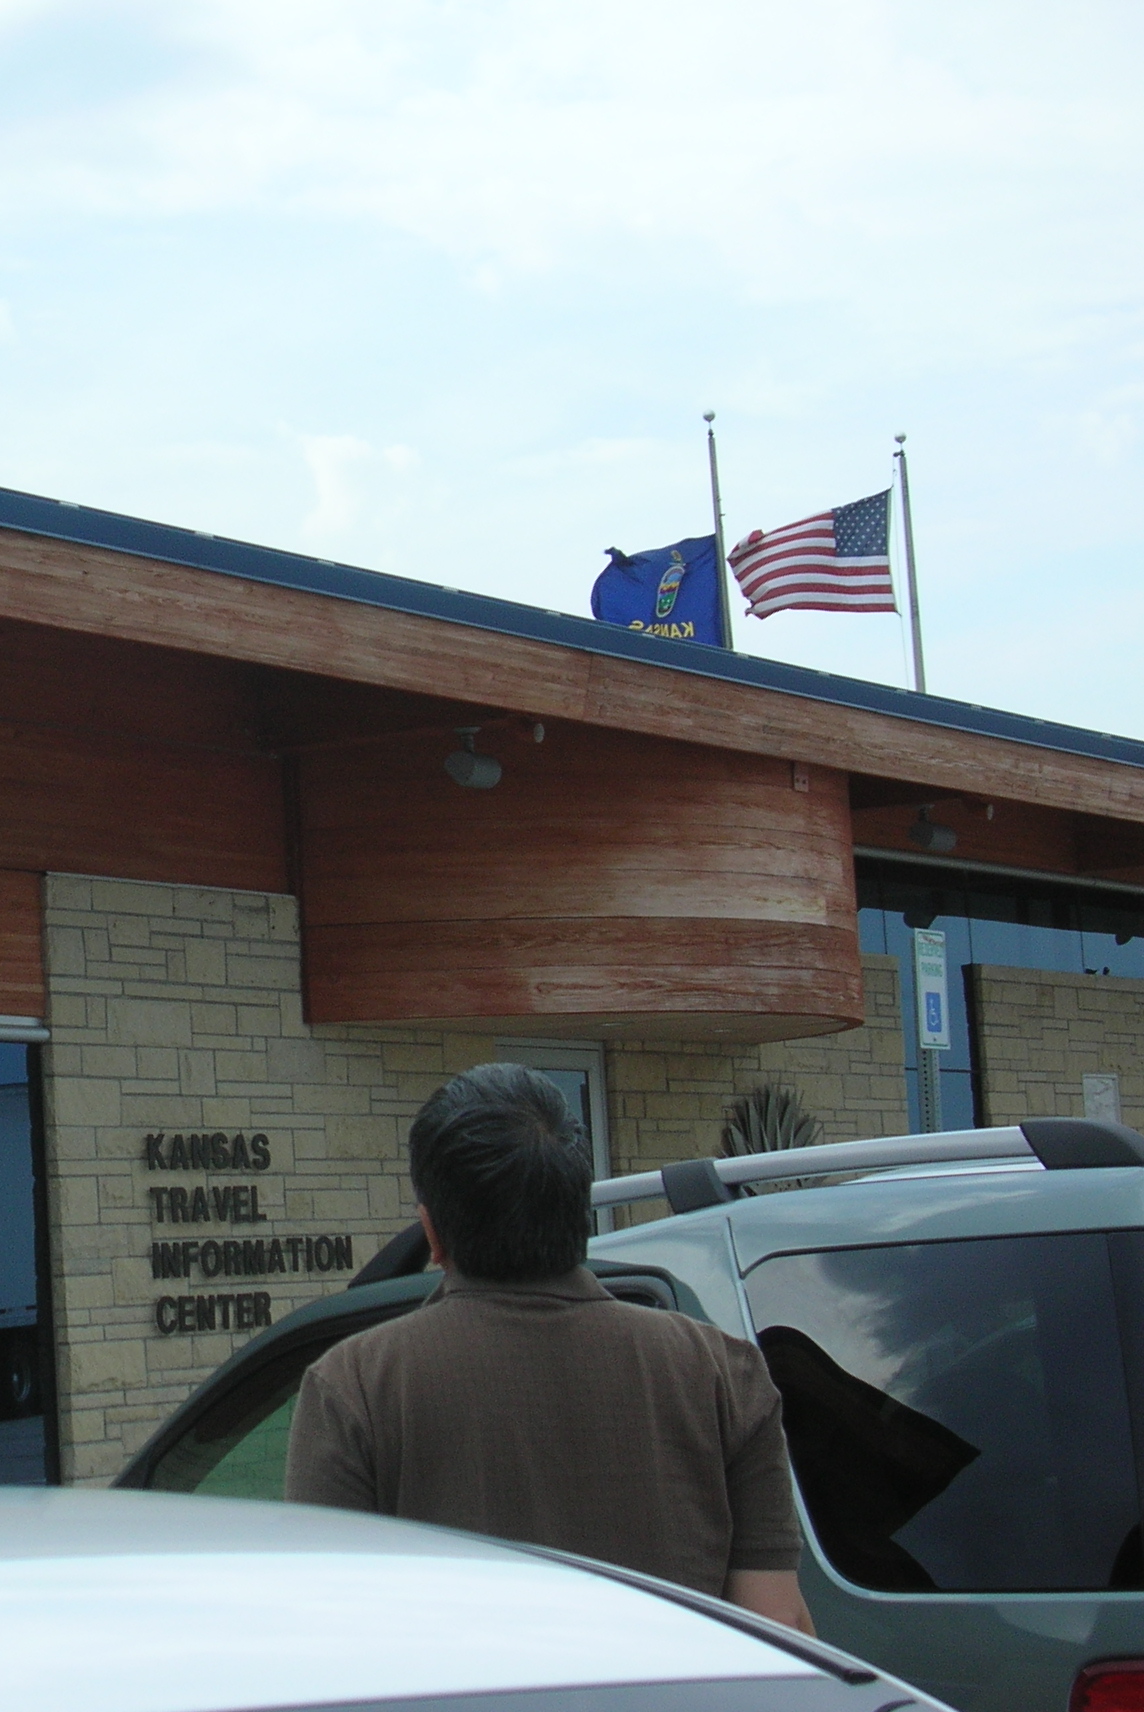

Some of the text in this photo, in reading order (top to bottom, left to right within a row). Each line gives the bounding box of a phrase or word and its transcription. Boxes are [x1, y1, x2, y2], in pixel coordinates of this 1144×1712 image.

[146, 1132, 271, 1170] KANSAS
[150, 1185, 267, 1223] TRAVEL
[152, 1235, 353, 1279] INFORMATION
[156, 1292, 272, 1334] CENTER
